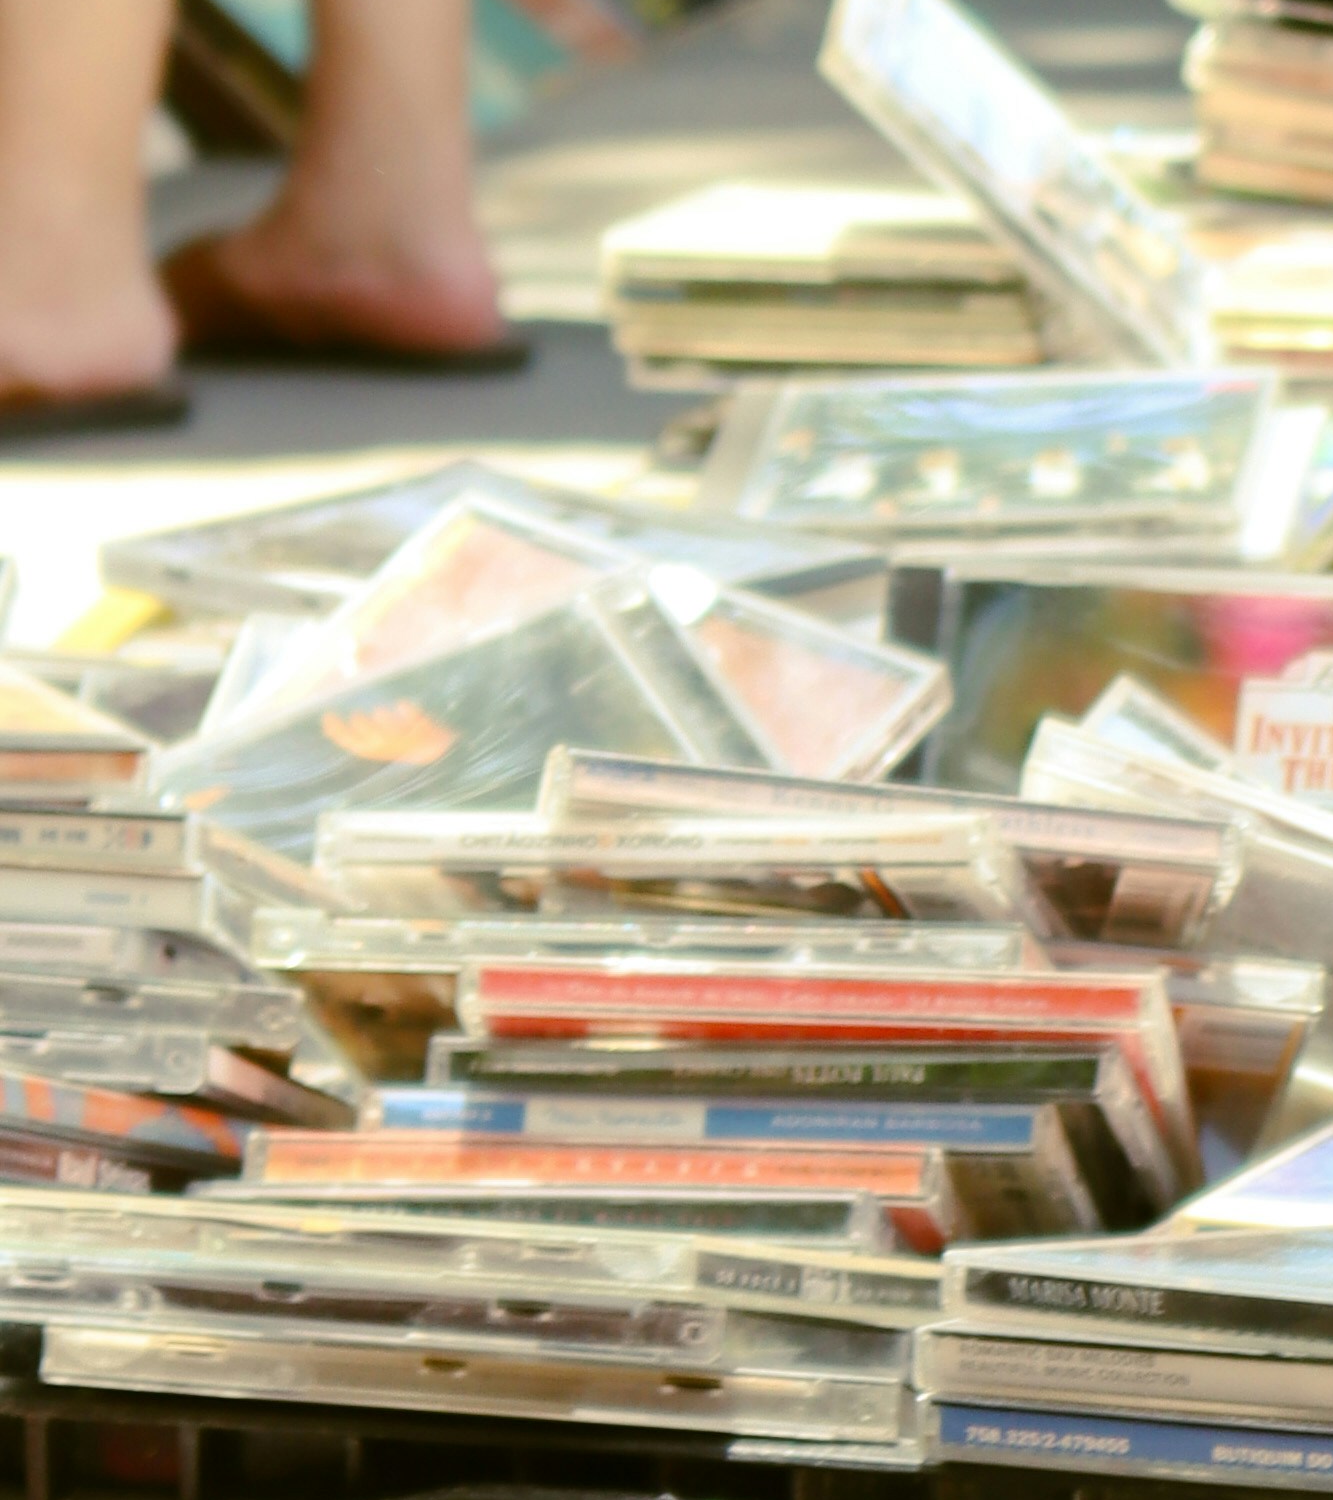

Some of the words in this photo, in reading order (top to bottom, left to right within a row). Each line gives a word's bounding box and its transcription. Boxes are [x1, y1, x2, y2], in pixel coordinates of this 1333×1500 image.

[1009, 1276, 1087, 1309] MARISA
[1090, 1284, 1165, 1316] MONTE
[1212, 1444, 1302, 1468] BUTIQUIM
[1307, 1450, 1333, 1470] DO
